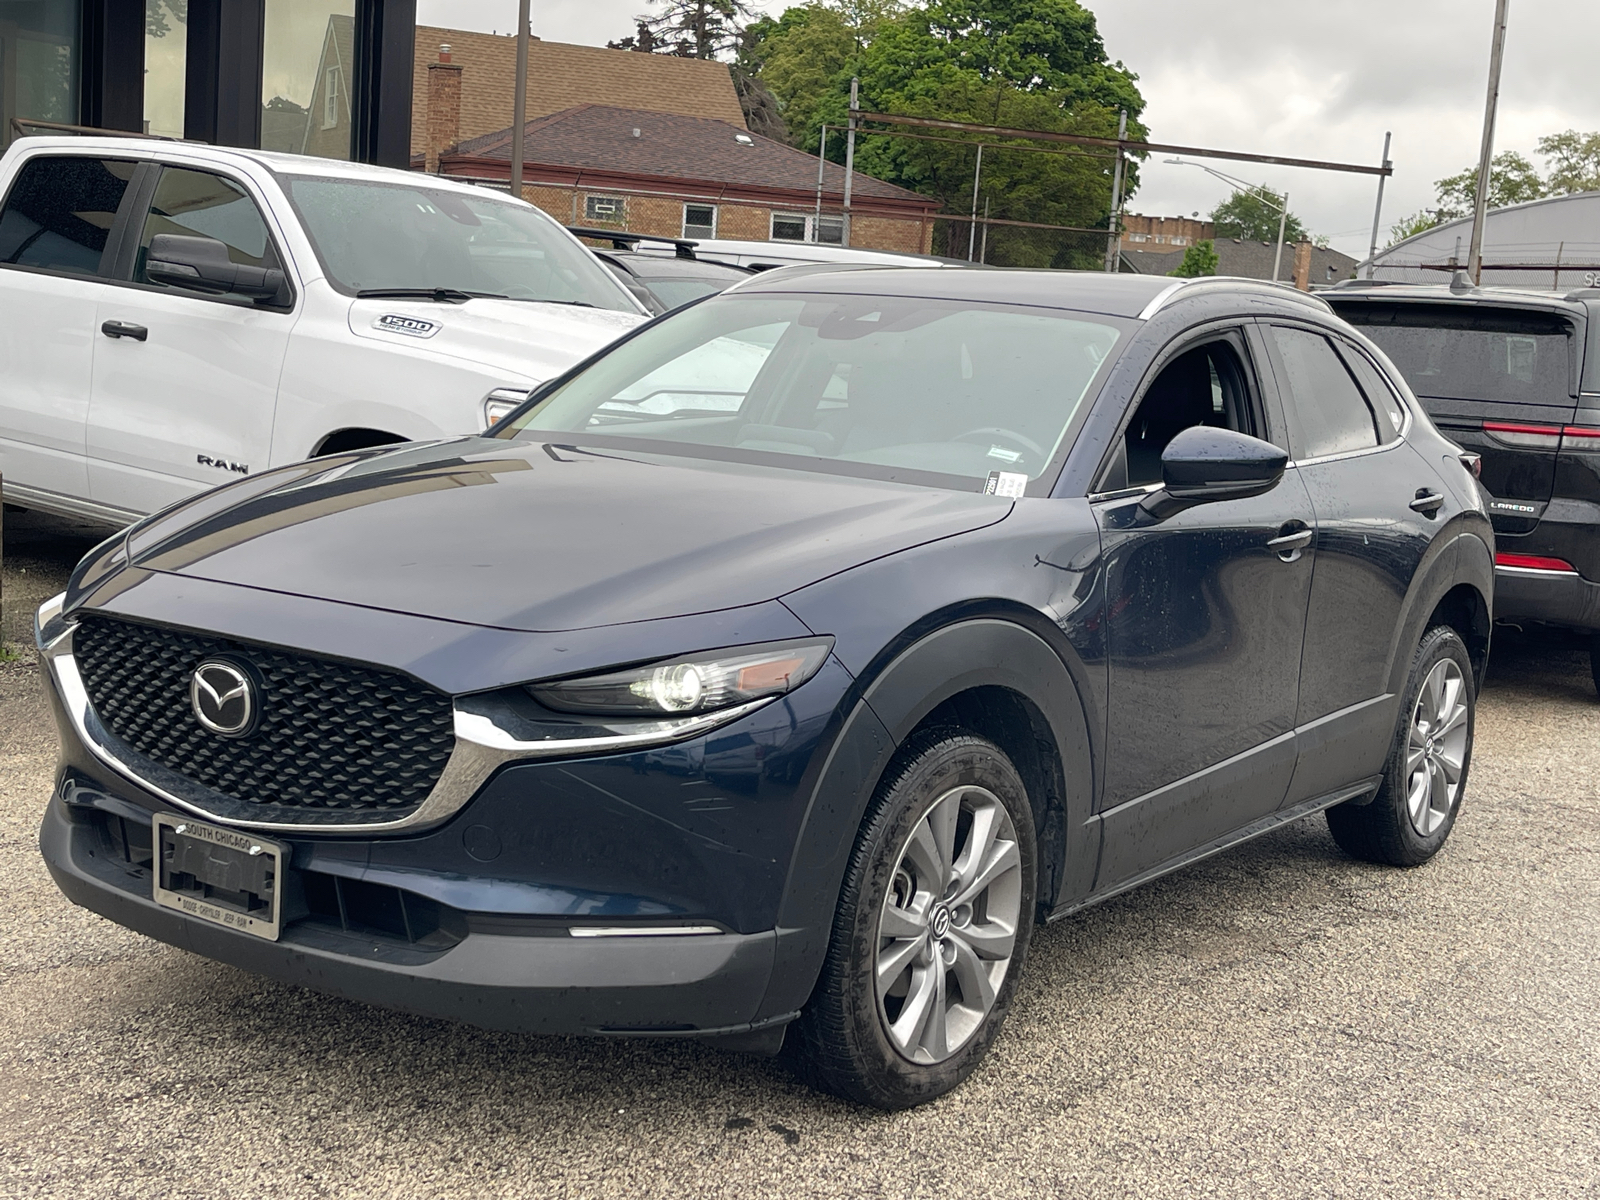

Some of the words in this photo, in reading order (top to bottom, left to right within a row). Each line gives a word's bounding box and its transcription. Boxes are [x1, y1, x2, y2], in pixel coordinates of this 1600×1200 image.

[384, 316, 431, 332] 1500
[197, 454, 249, 475] RAM
[1490, 502, 1535, 513] LAREDO
[185, 822, 214, 841] SOUTH
[215, 830, 251, 850] CHICAGO
